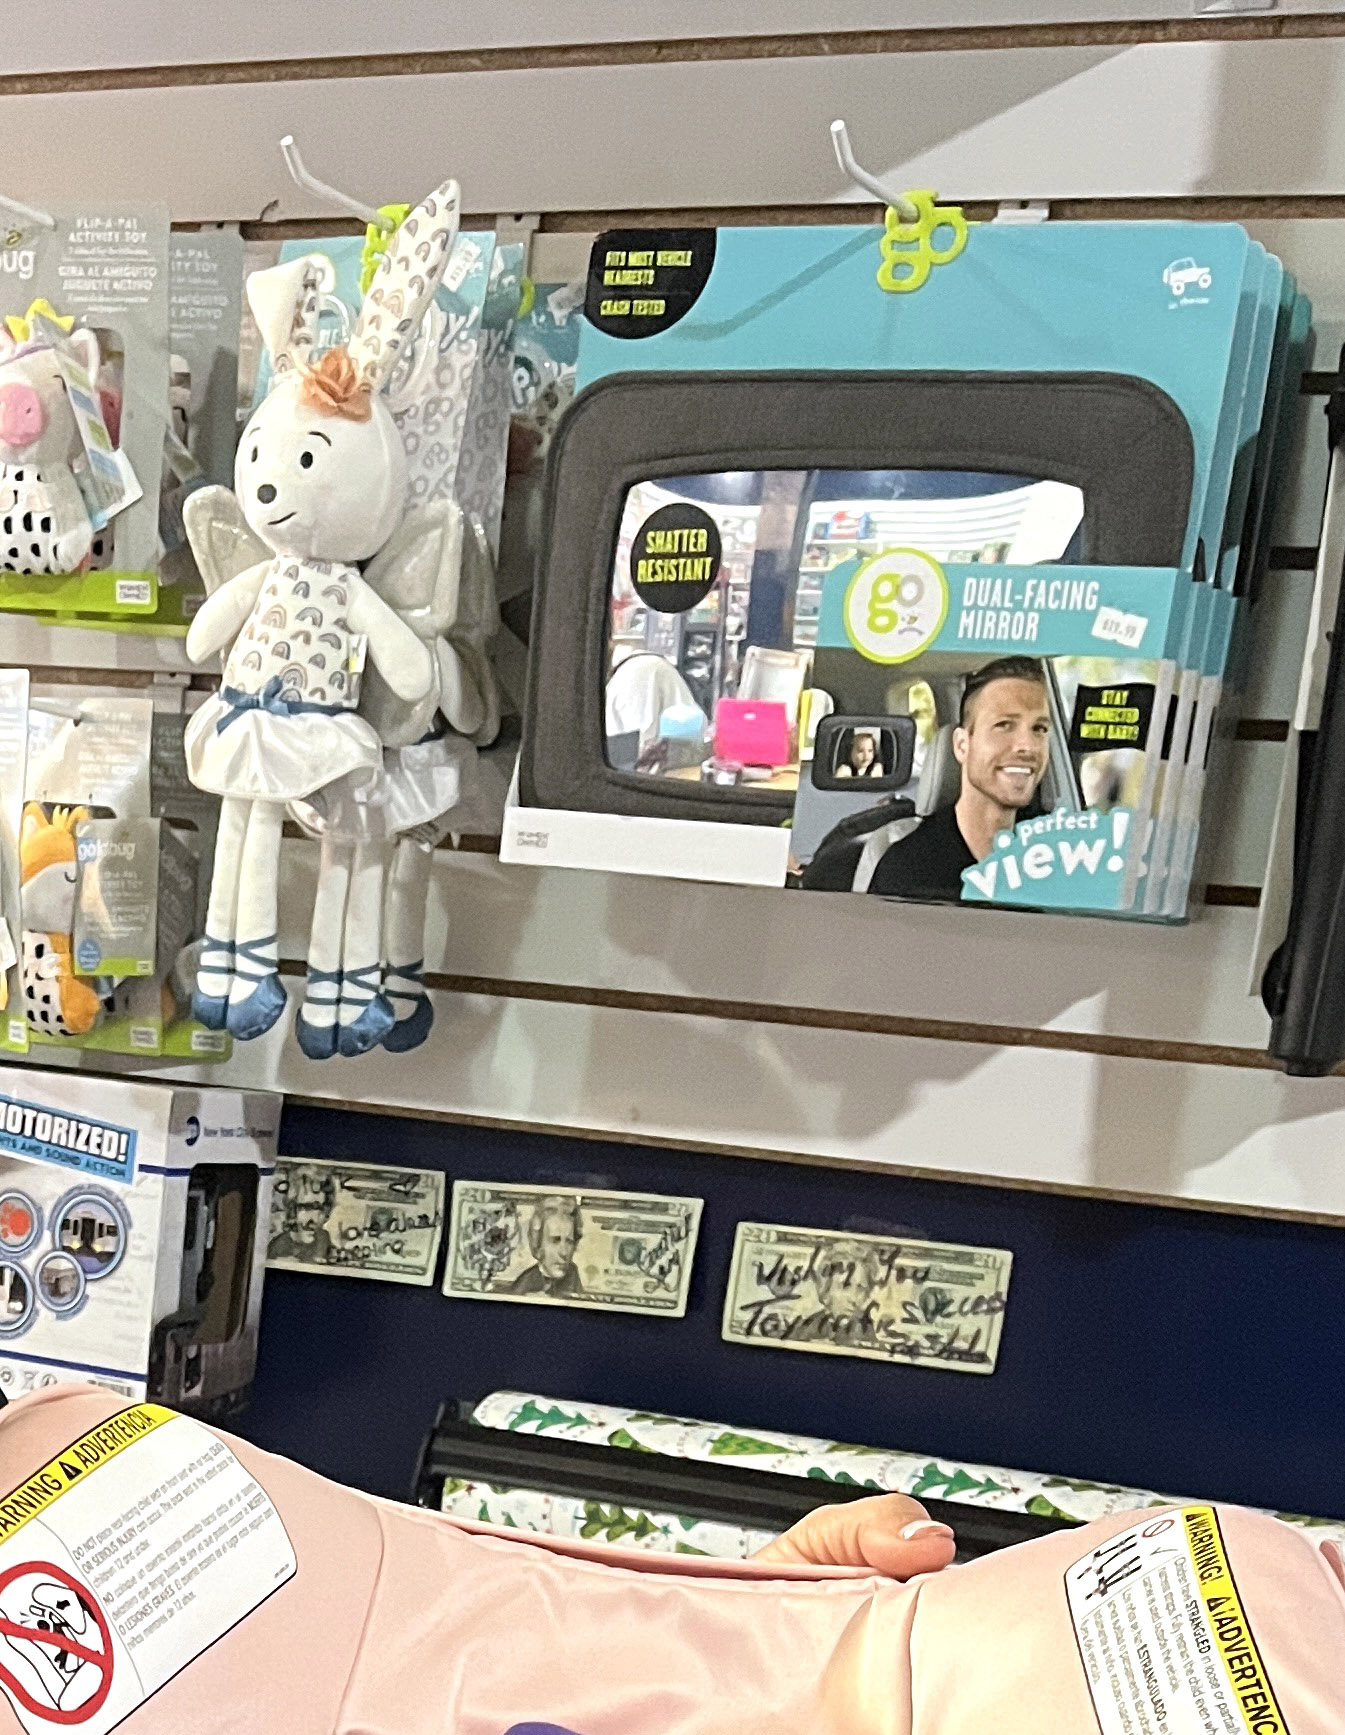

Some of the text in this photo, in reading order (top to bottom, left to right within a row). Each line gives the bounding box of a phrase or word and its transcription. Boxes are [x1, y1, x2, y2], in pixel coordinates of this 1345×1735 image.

[646, 529, 708, 554] SHATTER
[637, 557, 714, 583] RESISTANT
[867, 573, 924, 634] go
[962, 577, 1100, 611] DUAL-FACING
[958, 609, 1040, 641] MIRROR
[1020, 807, 1099, 847] perfect
[966, 812, 1131, 899] view!
[76, 1410, 158, 1471] ADVERTENCIA
[1187, 1521, 1225, 1587] WARNING!
[1186, 1600, 1211, 1653] STRANGLED
[1204, 1664, 1220, 1689] loose
[1137, 1644, 1167, 1721] ESTRANGULADO
[1188, 1677, 1205, 1697] child
[1195, 1698, 1210, 1720] even
